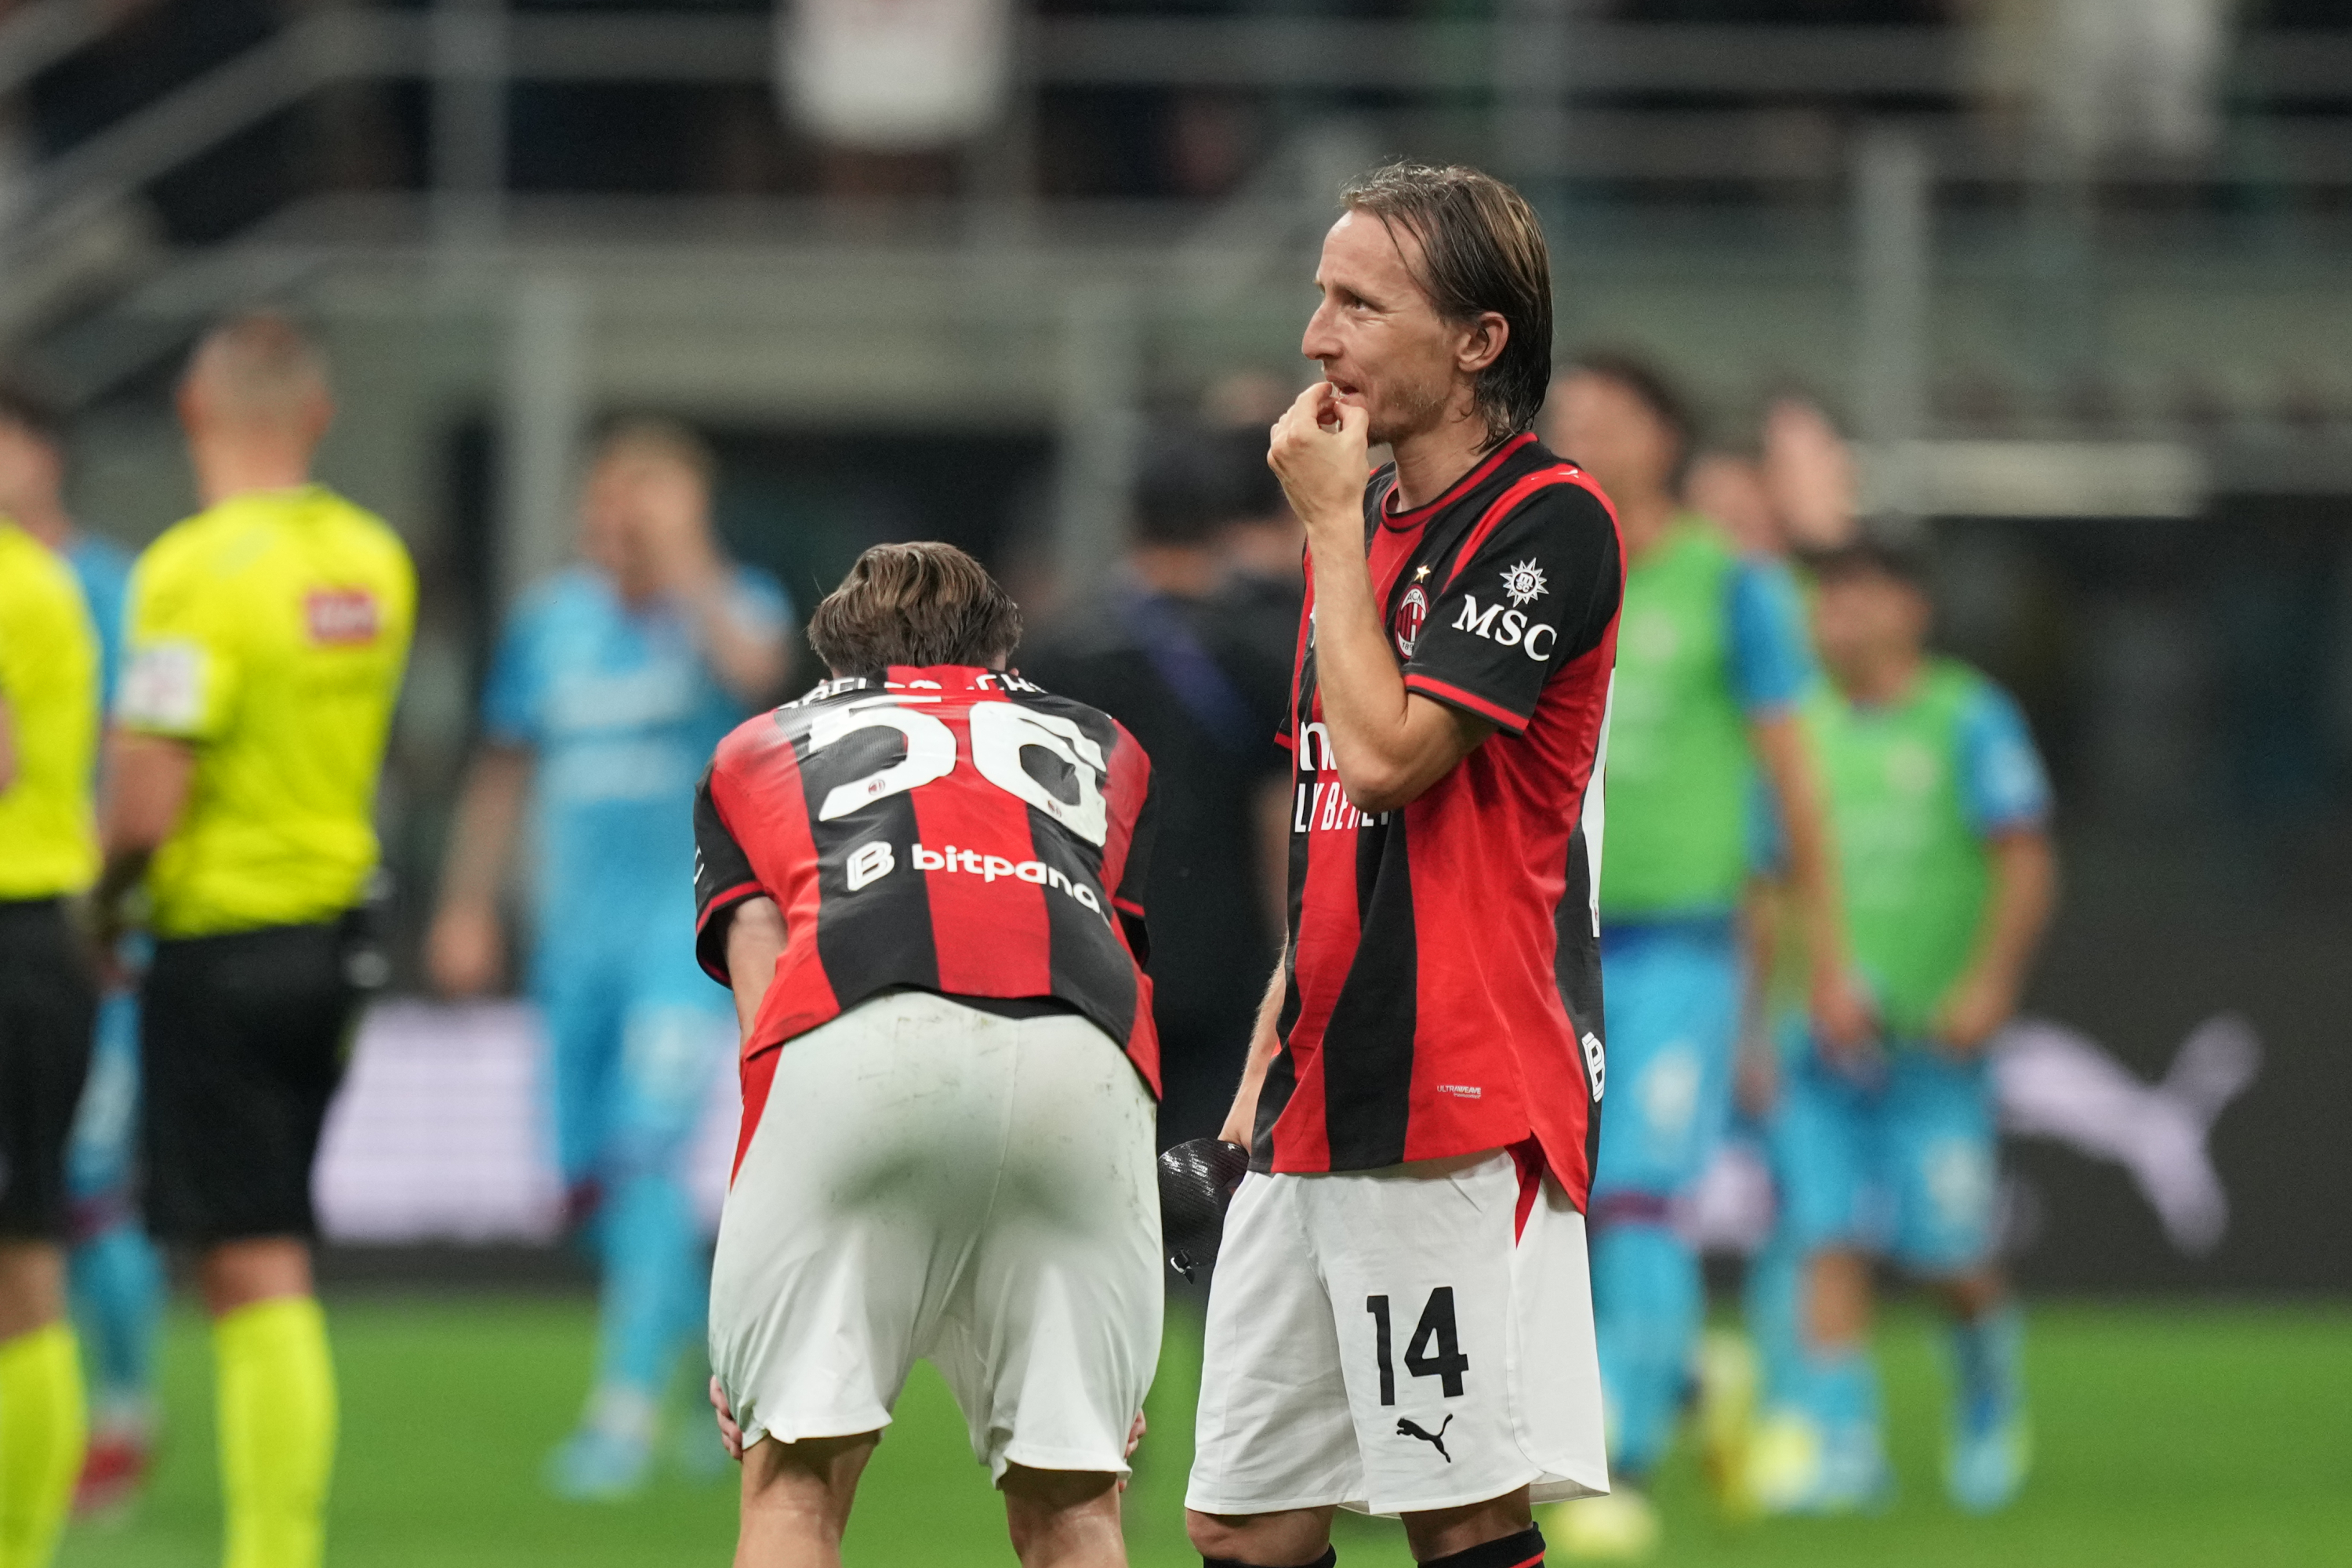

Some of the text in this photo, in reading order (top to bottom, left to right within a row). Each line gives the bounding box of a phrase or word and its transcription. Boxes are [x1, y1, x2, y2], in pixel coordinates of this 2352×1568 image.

[1406, 590, 1424, 605] ACM
[1402, 642, 1414, 652] 189
[1451, 593, 1558, 662] MSC
[1294, 782, 1325, 833] LY
[1366, 1286, 1468, 1406] 14
